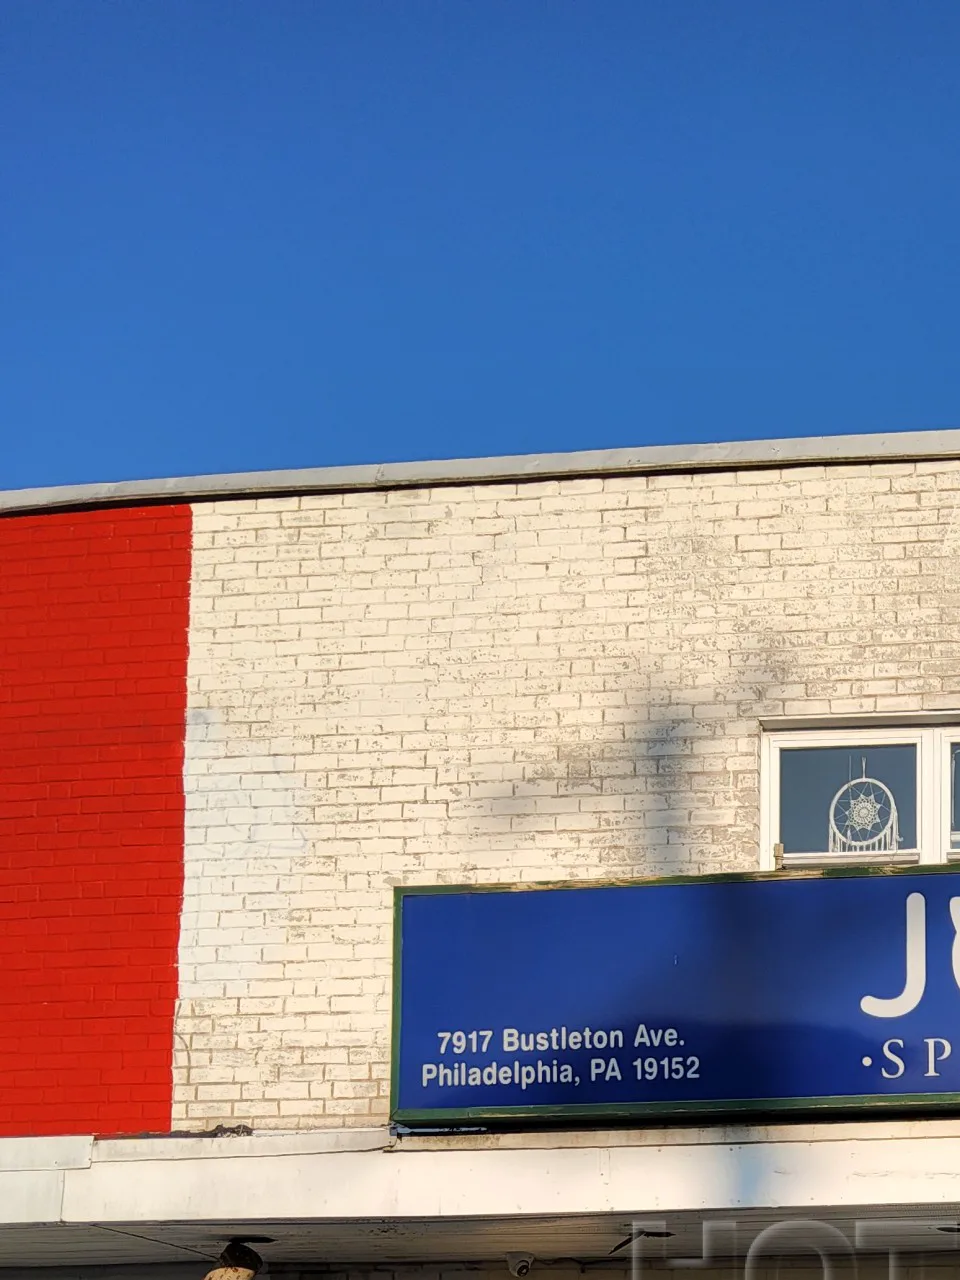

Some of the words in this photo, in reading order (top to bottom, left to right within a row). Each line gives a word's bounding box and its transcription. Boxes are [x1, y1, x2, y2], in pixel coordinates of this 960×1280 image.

[437, 1030, 493, 1056] 7917
[502, 1025, 624, 1053] Bustleton
[633, 1024, 686, 1048] Ave.
[421, 1060, 581, 1090] Philadelphia,
[590, 1060, 622, 1083] PA
[633, 1056, 701, 1081] 19152
